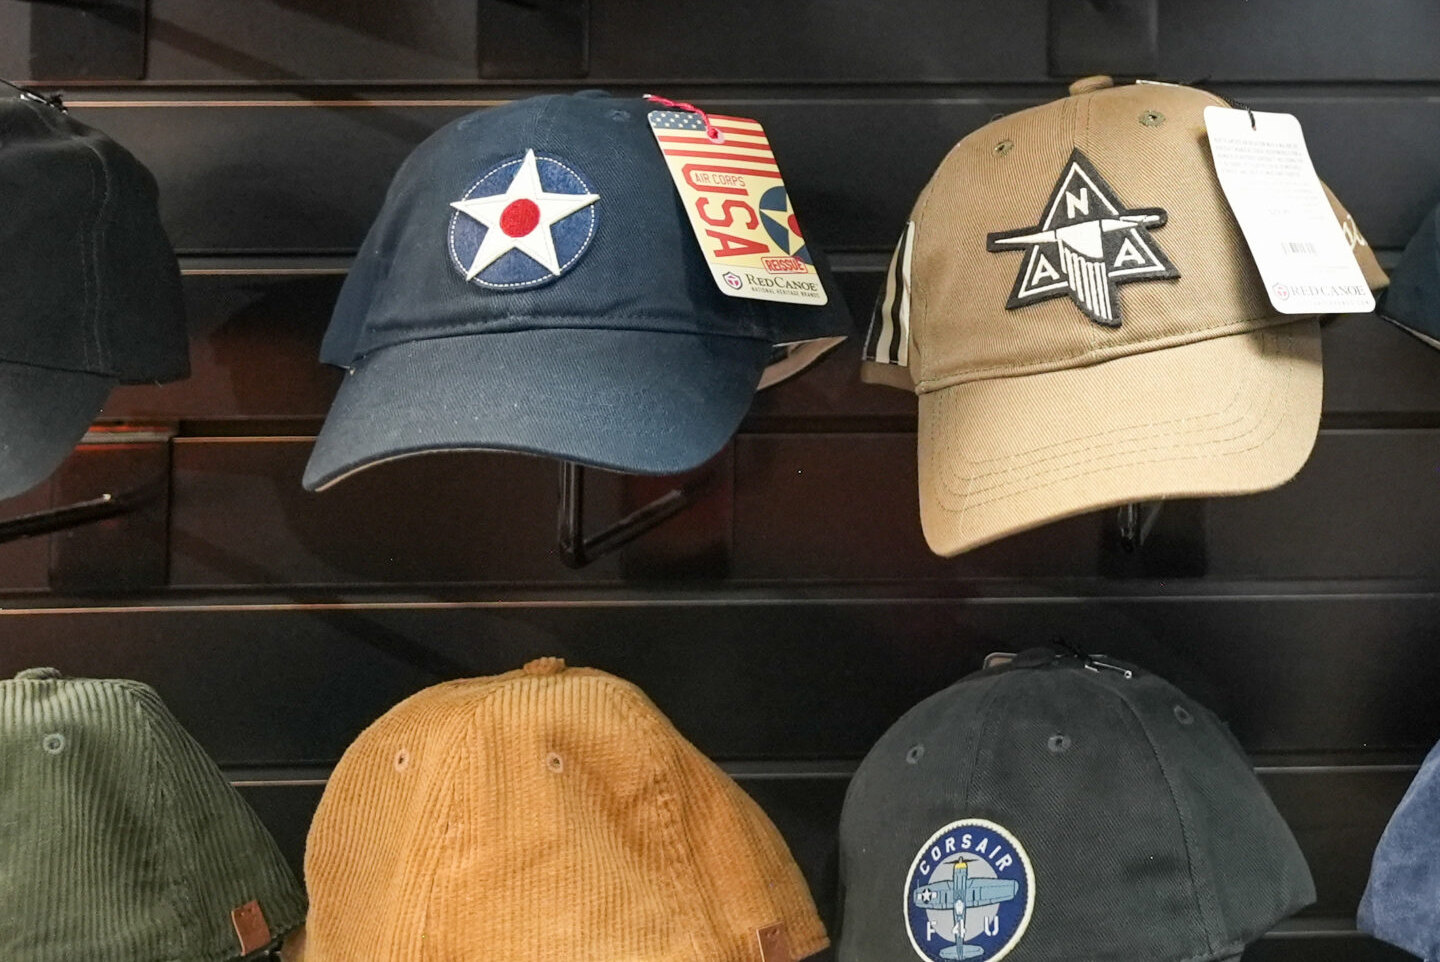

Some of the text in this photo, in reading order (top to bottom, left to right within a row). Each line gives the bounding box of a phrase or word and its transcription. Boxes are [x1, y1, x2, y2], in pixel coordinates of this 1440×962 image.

[694, 172, 746, 187] AIR CORPS
[681, 162, 771, 258] USA
[764, 259, 805, 271] REISSUE
[919, 833, 1013, 876] CORSAIR
